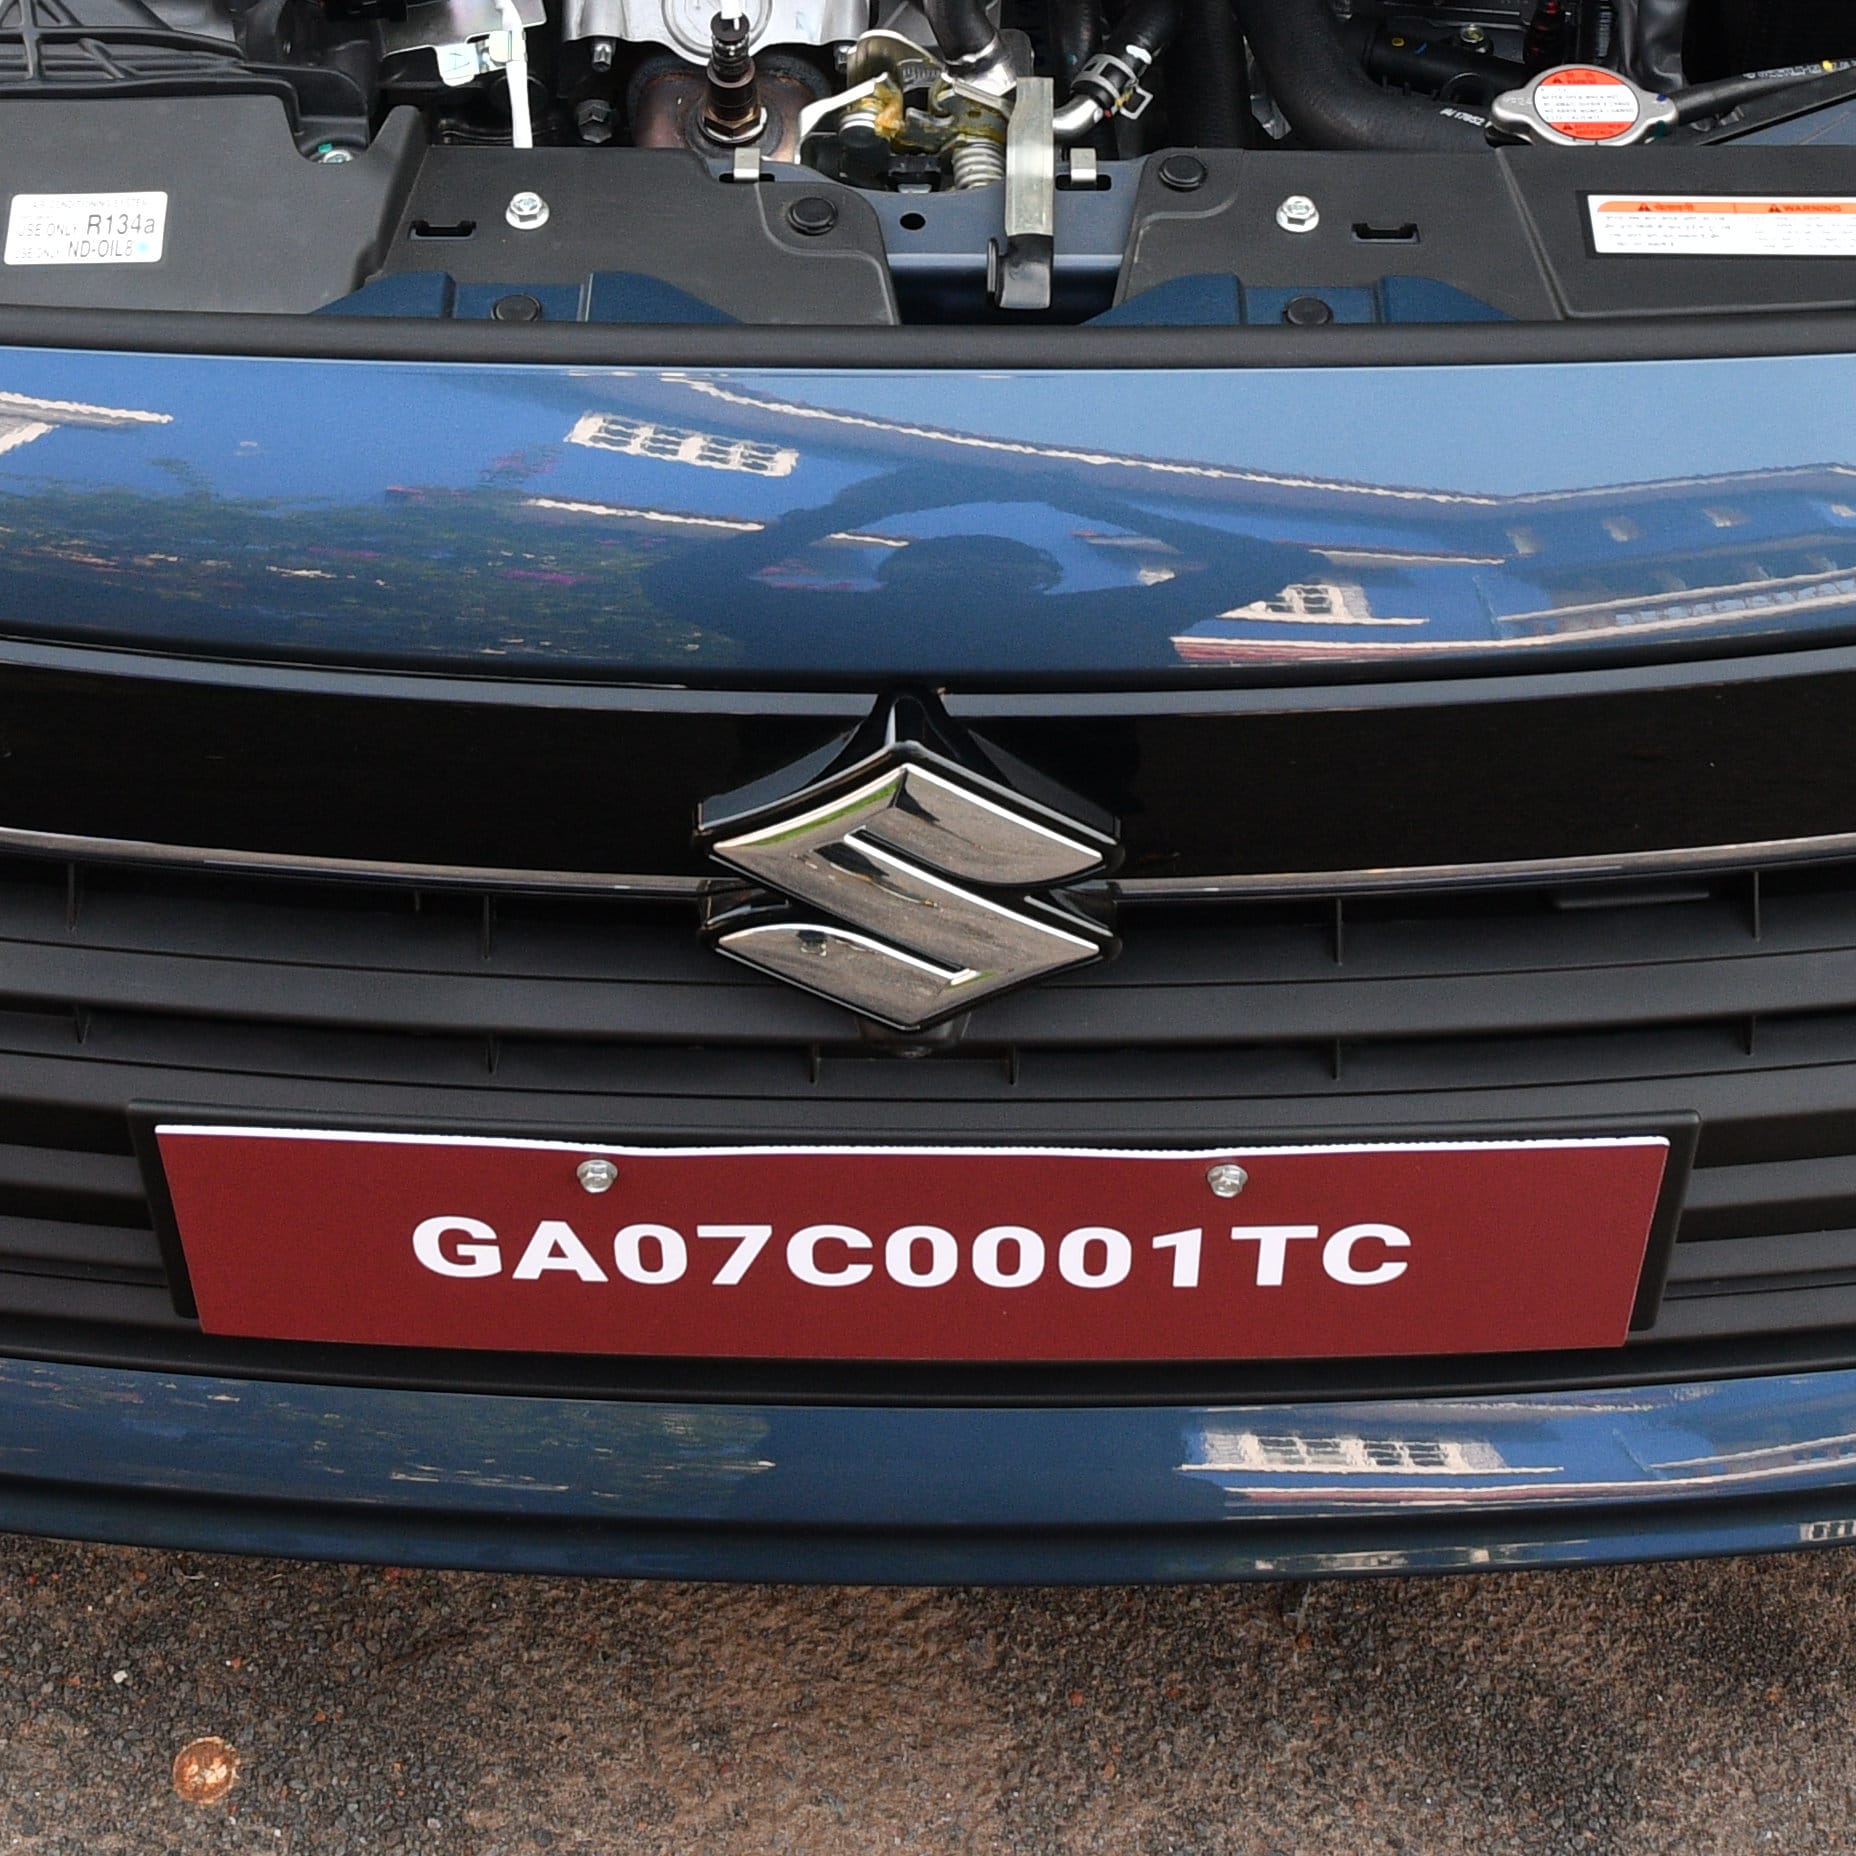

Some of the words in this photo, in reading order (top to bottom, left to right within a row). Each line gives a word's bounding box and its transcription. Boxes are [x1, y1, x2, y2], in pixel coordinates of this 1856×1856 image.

[1783, 204, 1842, 213] WARNING
[86, 213, 156, 236] R134a
[412, 1213, 1411, 1288] GA07C0001TC
